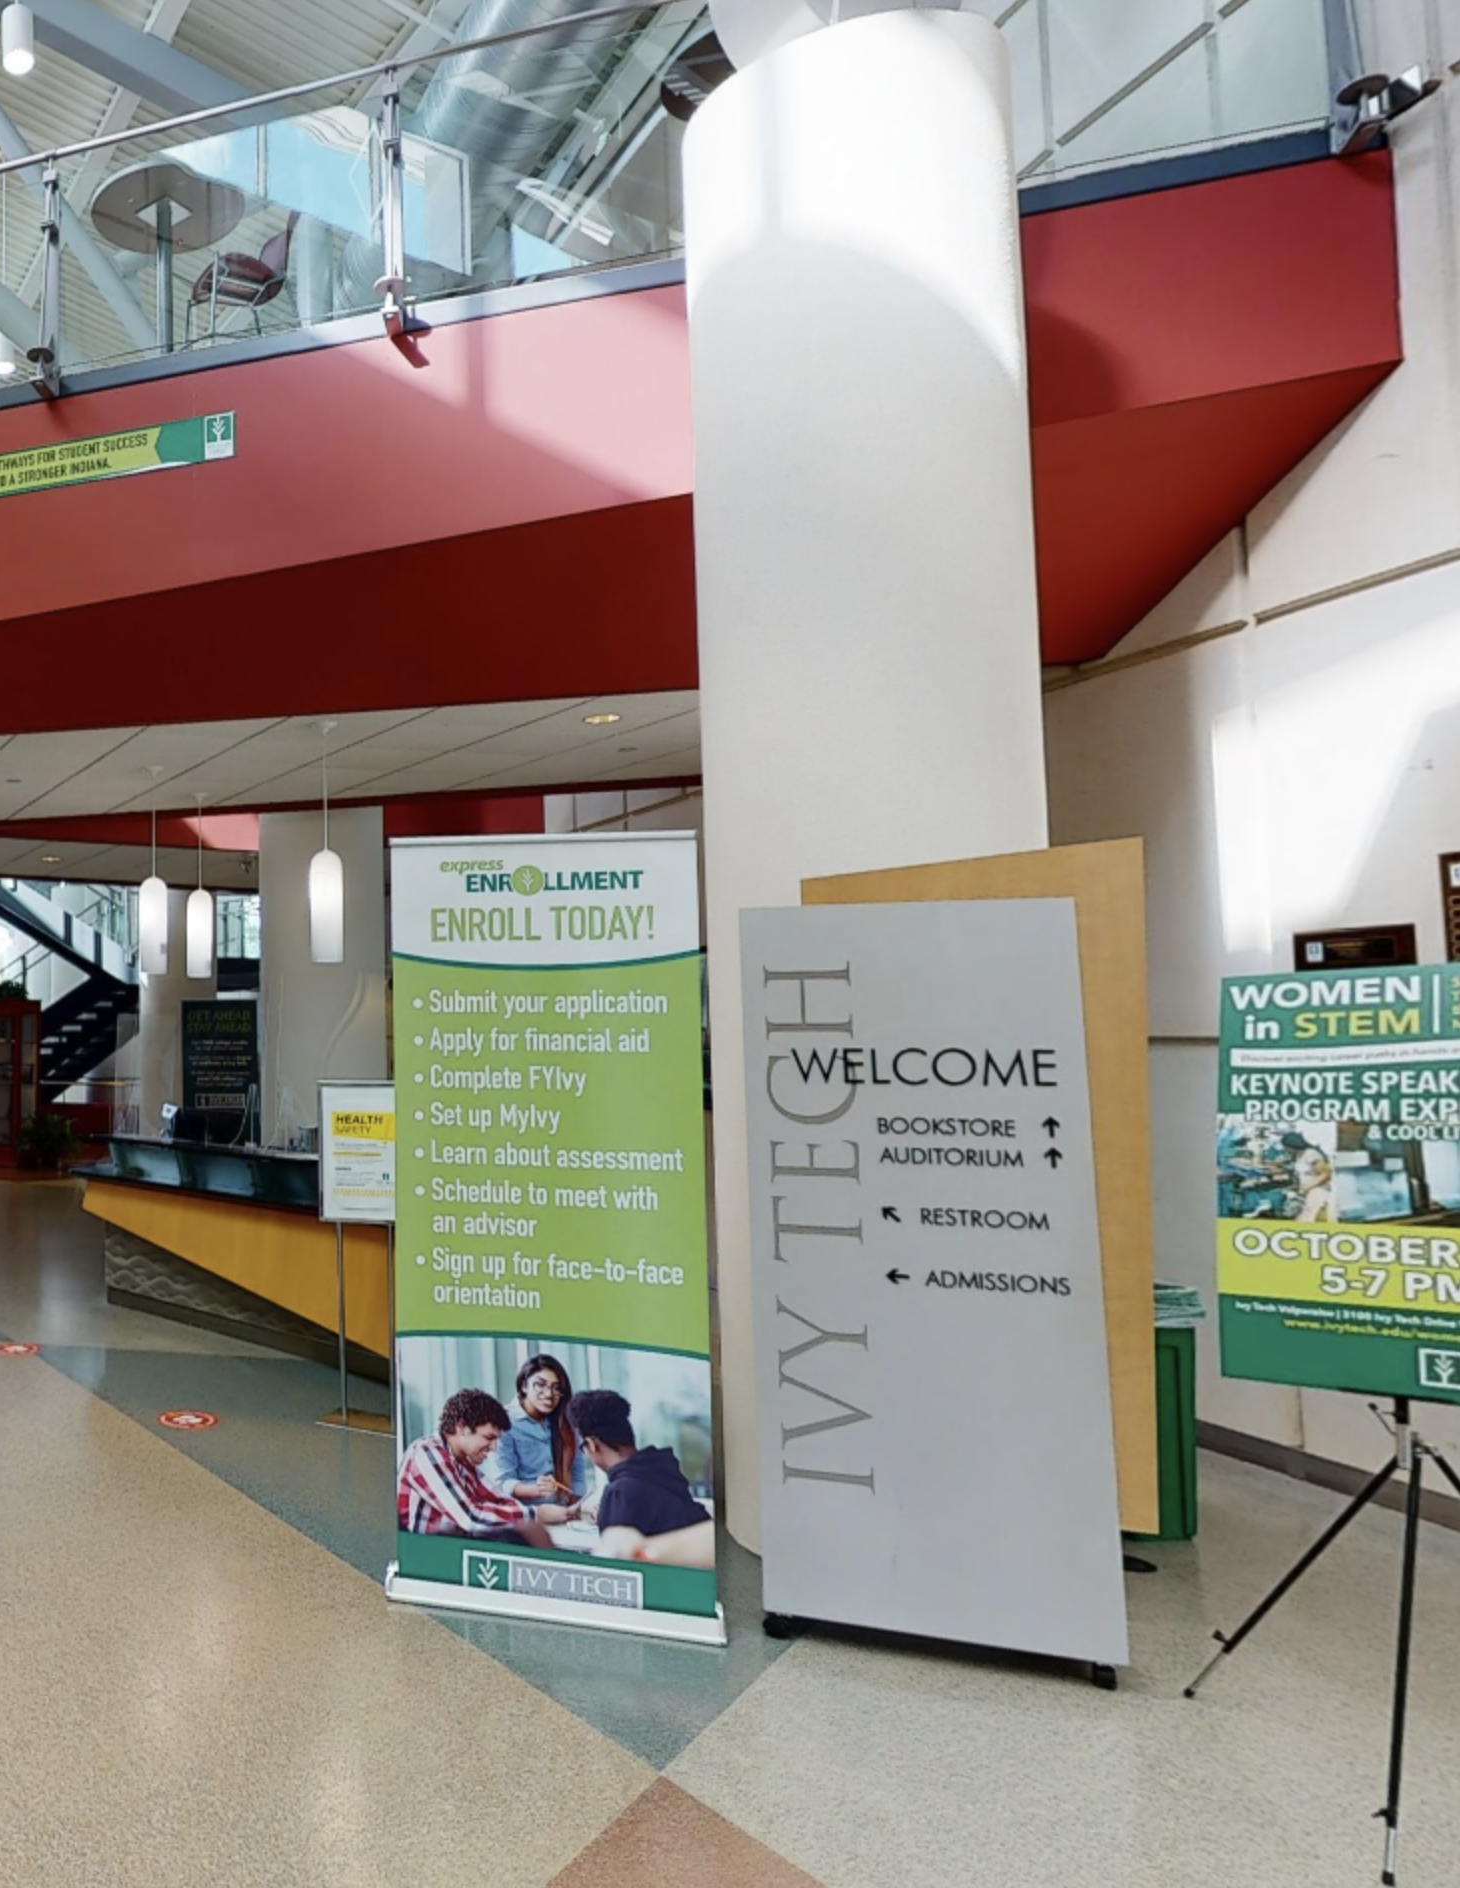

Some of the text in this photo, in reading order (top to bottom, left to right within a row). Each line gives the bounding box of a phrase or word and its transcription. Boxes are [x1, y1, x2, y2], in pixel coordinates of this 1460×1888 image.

[37, 450, 57, 466] FOR
[58, 442, 101, 462] STUDENT
[102, 433, 148, 454] SUCCESS
[8, 473, 16, 486] A
[17, 465, 68, 486] STRONGER
[69, 458, 112, 478] INDIANA.
[438, 859, 505, 877] express
[429, 905, 656, 943] ENROLL TODAY!
[429, 989, 669, 1020] Submit your application
[1229, 974, 1422, 1011] WOMEN
[1244, 1013, 1281, 1041] in
[1293, 1008, 1420, 1040] STEM
[429, 1027, 651, 1057] Apply for financial aid
[430, 1064, 587, 1097] Complete FYIvy
[790, 1047, 1058, 1087] WELCOME
[1230, 1069, 1460, 1096] KEYNOTE SPEAK
[336, 1114, 383, 1125] HEALTH
[430, 1101, 561, 1135] Set up MyIvy
[1244, 1097, 1459, 1122] PROGRAM EXP
[335, 1125, 372, 1135] SAFETY
[876, 1116, 1017, 1138] BOOKSTORE
[1367, 1124, 1382, 1140] &
[1386, 1123, 1440, 1140] COOL
[431, 1140, 684, 1173] Learn about assessment
[879, 1146, 1025, 1168] AUDITORIUM
[431, 1177, 659, 1211] Schedule to meet with
[433, 1212, 538, 1238] an advisor
[763, 960, 876, 1496] IVY TECH
[919, 1207, 1050, 1231] RESTROOM
[1233, 1228, 1460, 1269] OCTOBER
[431, 1247, 684, 1286] Sign up for face-to-face
[1321, 1265, 1389, 1298] 5-7
[434, 1280, 542, 1309] orientation
[924, 1269, 1072, 1296] ADMISSIONS
[515, 1565, 559, 1591] IVY
[563, 1572, 634, 1601] TECH
